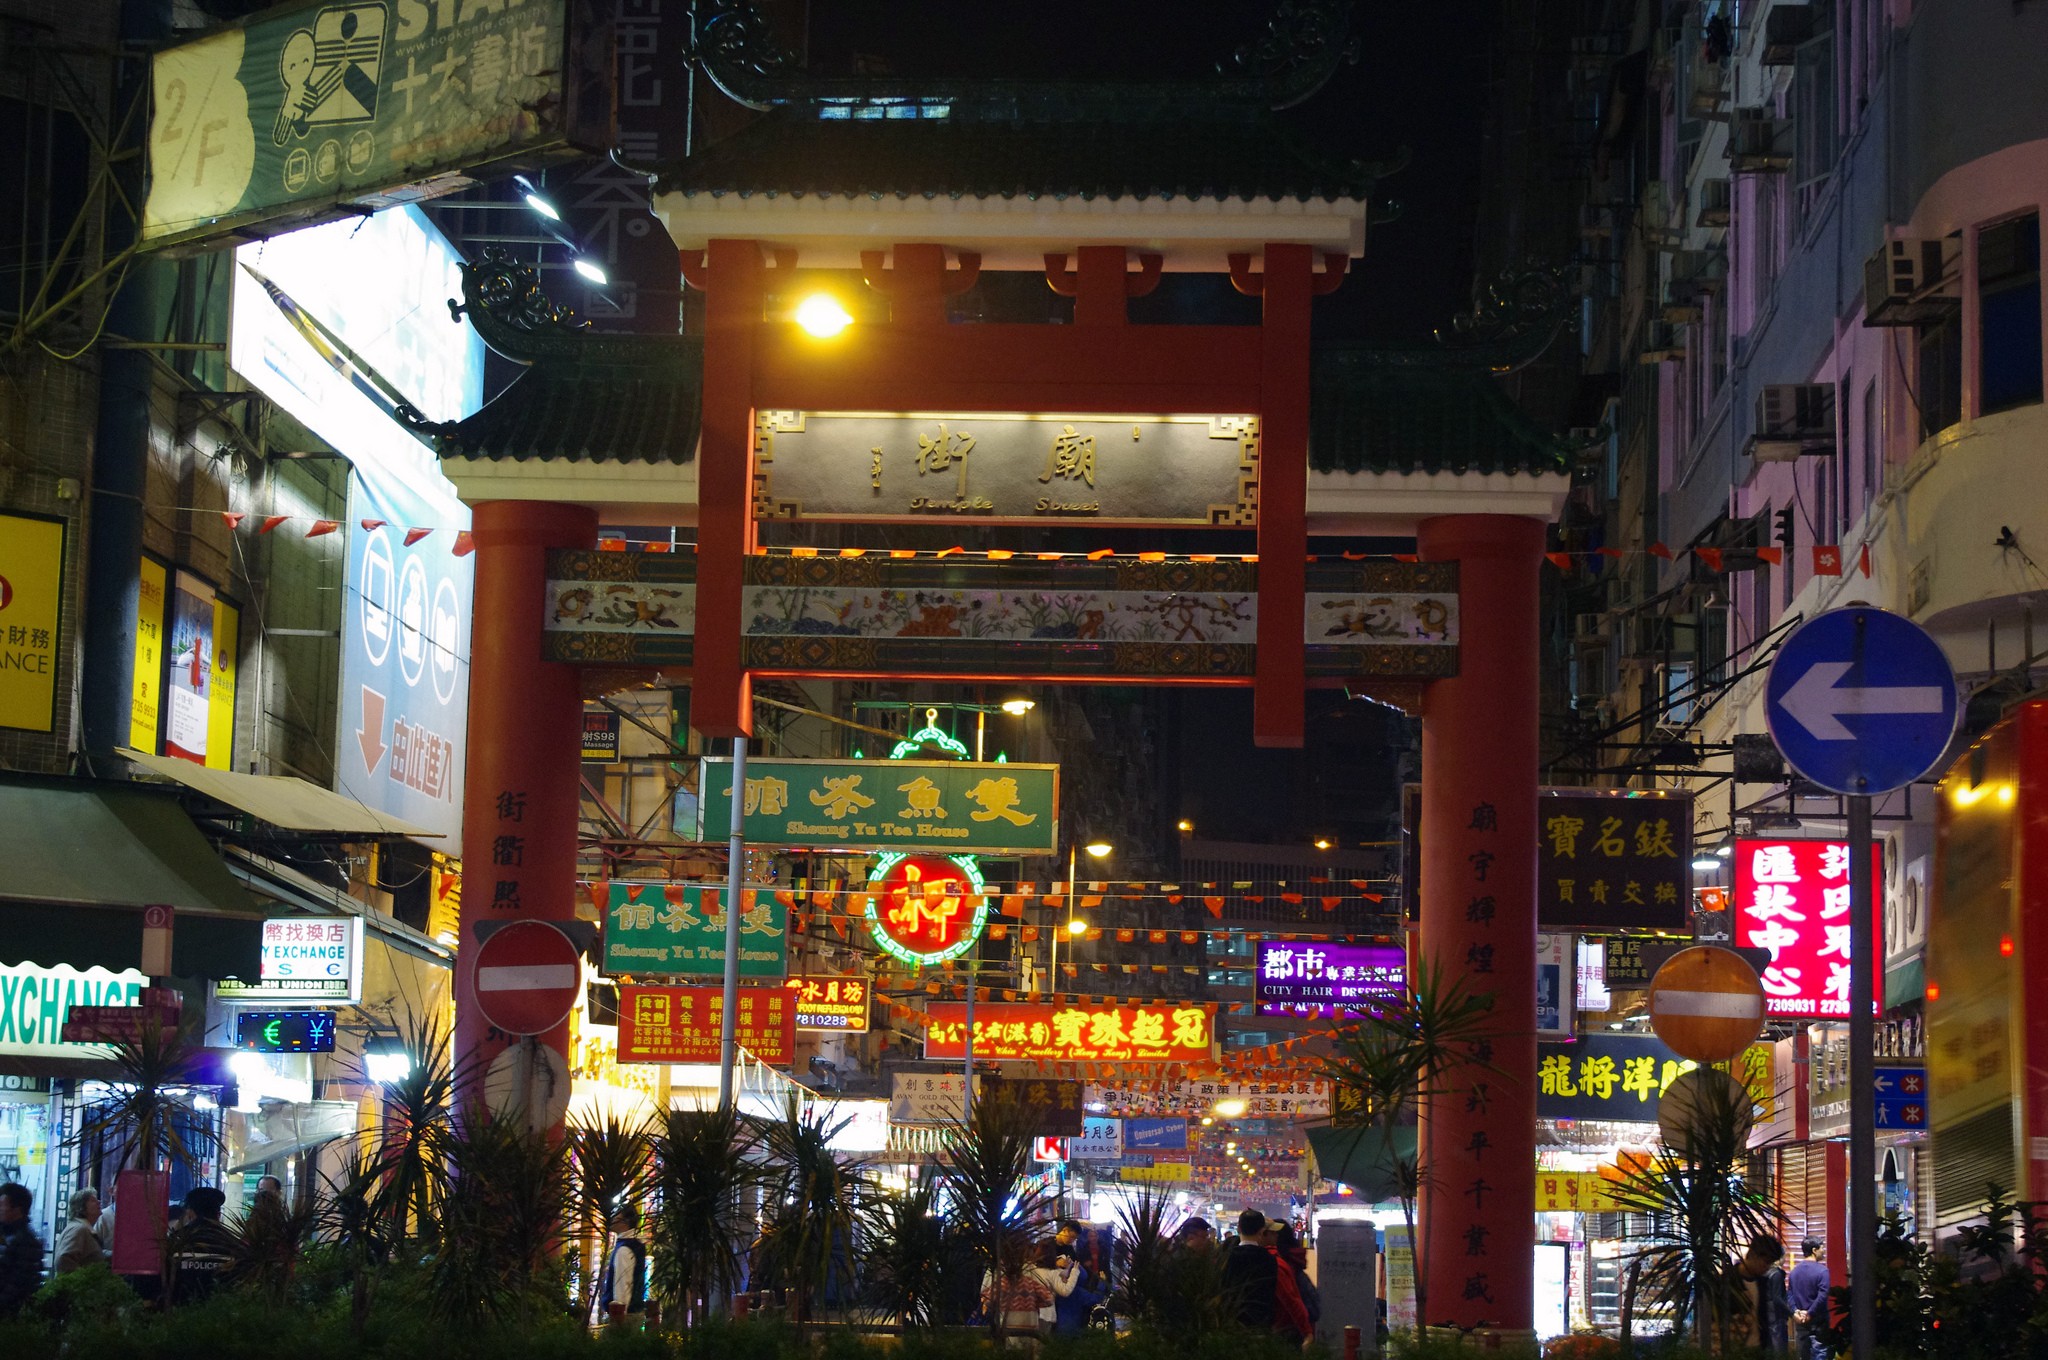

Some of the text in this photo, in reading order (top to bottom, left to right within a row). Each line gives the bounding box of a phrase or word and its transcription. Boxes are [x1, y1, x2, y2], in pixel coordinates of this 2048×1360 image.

[160, 64, 230, 190] 2/F
[910, 496, 1100, 512] Temple Street
[0, 626, 50, 649] 財務
[389, 714, 453, 804] 由此進入
[786, 821, 970, 839] Sheung Yu Tea House
[1744, 845, 1807, 996] 匯款中心
[274, 946, 345, 959] EXCHANGE
[610, 943, 668, 961] Sheung
[672, 945, 694, 959] Yu
[219, 981, 280, 989] WESRN
[281, 981, 323, 989] UNION
[1263, 986, 1399, 998] CITY HAIR DRESSIN
[798, 1003, 816, 1013] FOOT
[1263, 1002, 1384, 1013] & BEAUTY PRODUC
[1766, 999, 1816, 1013] 7309031
[757, 1048, 782, 1056] 1707
[1136, 1049, 1171, 1058] Limited
[0, 1075, 36, 1089] ION
[60, 1097, 74, 1166] WESTRN
[57, 1174, 70, 1218] UNION
[189, 1261, 218, 1270] POLICE
